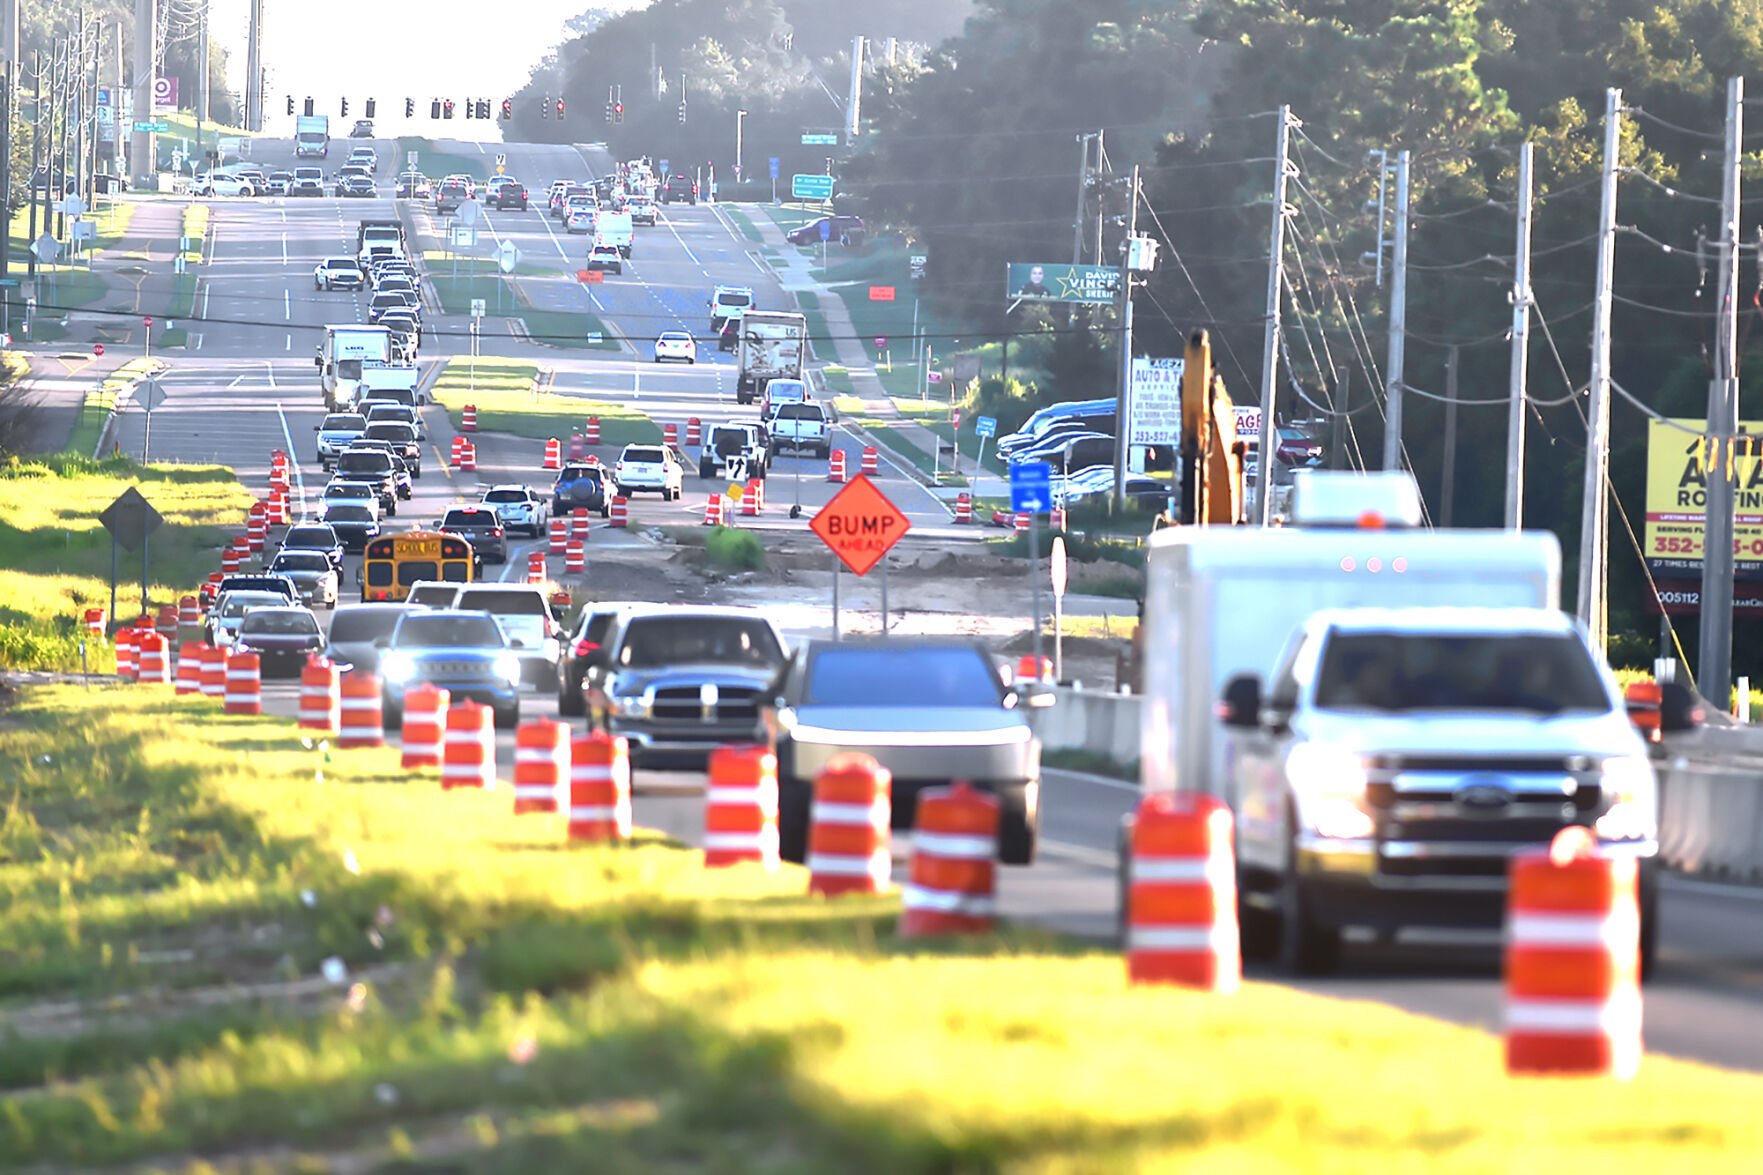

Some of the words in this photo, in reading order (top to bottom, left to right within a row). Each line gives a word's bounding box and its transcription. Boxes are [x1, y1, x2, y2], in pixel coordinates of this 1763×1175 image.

[1069, 279, 1121, 289] VINCE
[1086, 290, 1114, 298] SHERIF
[1135, 370, 1161, 382] AUTO
[1135, 431, 1178, 442] 352-527-4
[828, 515, 896, 535] BUMP
[838, 539, 885, 552] AHEAD
[1664, 560, 1687, 568] TIMES
